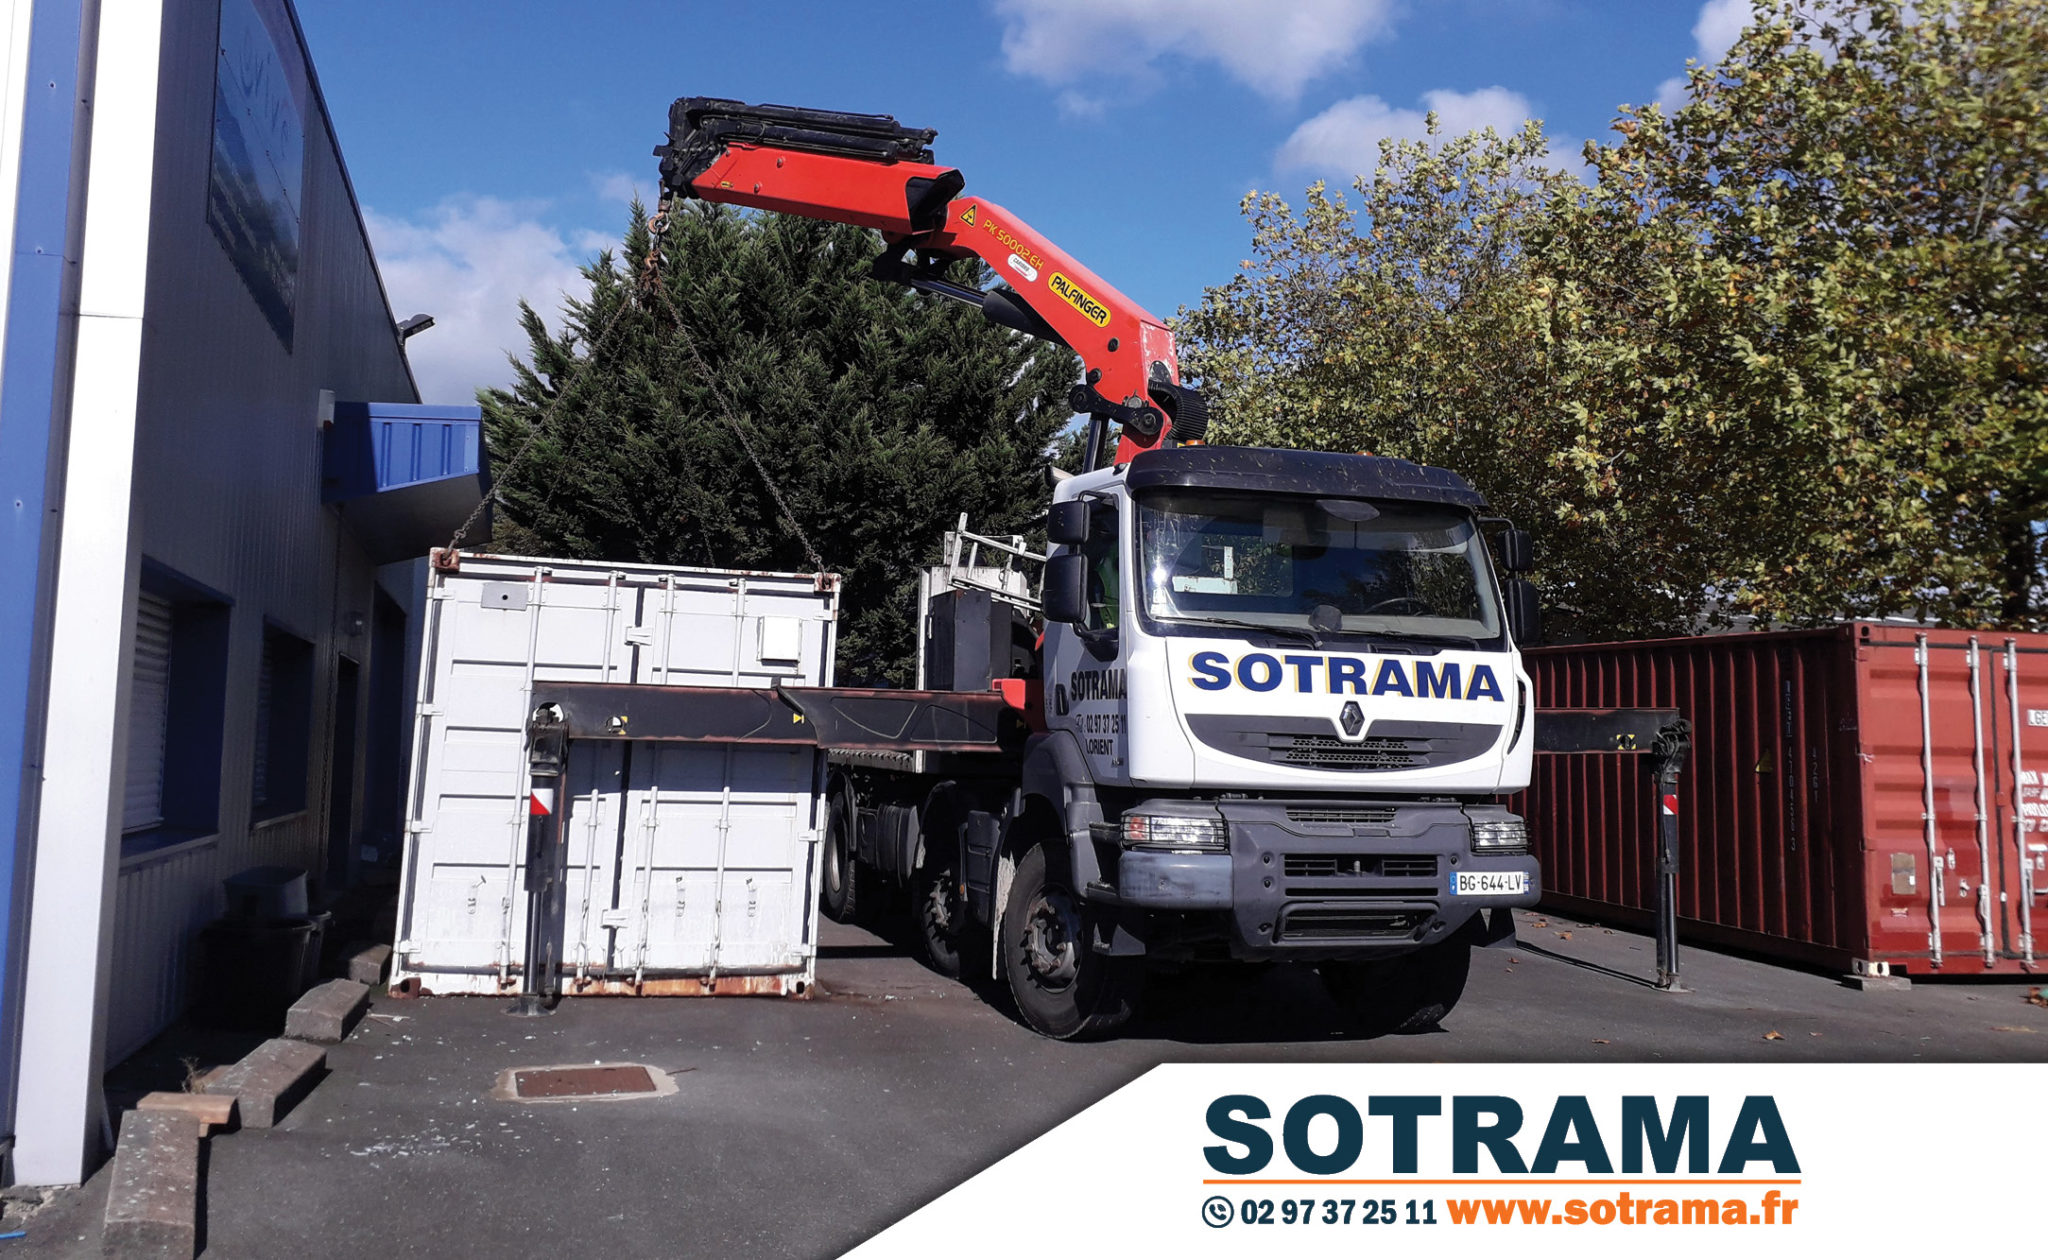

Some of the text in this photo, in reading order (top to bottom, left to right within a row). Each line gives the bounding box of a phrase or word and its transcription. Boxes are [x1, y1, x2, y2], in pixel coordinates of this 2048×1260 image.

[983, 219, 996, 236] PK
[996, 229, 1031, 260] 50002
[1029, 254, 1045, 270] EH
[1051, 276, 1108, 324] PALFINGER
[1071, 668, 1127, 701] SOTRAMA
[1187, 651, 1505, 702] SOTRAMA
[1086, 714, 1094, 733] 02
[1094, 714, 1102, 733] 97
[1103, 714, 1110, 733] 37
[1112, 714, 1120, 733] 25
[1121, 714, 1127, 734] 11
[1085, 739, 1113, 755] LORIENT
[1460, 874, 1521, 891] BG-644-LV
